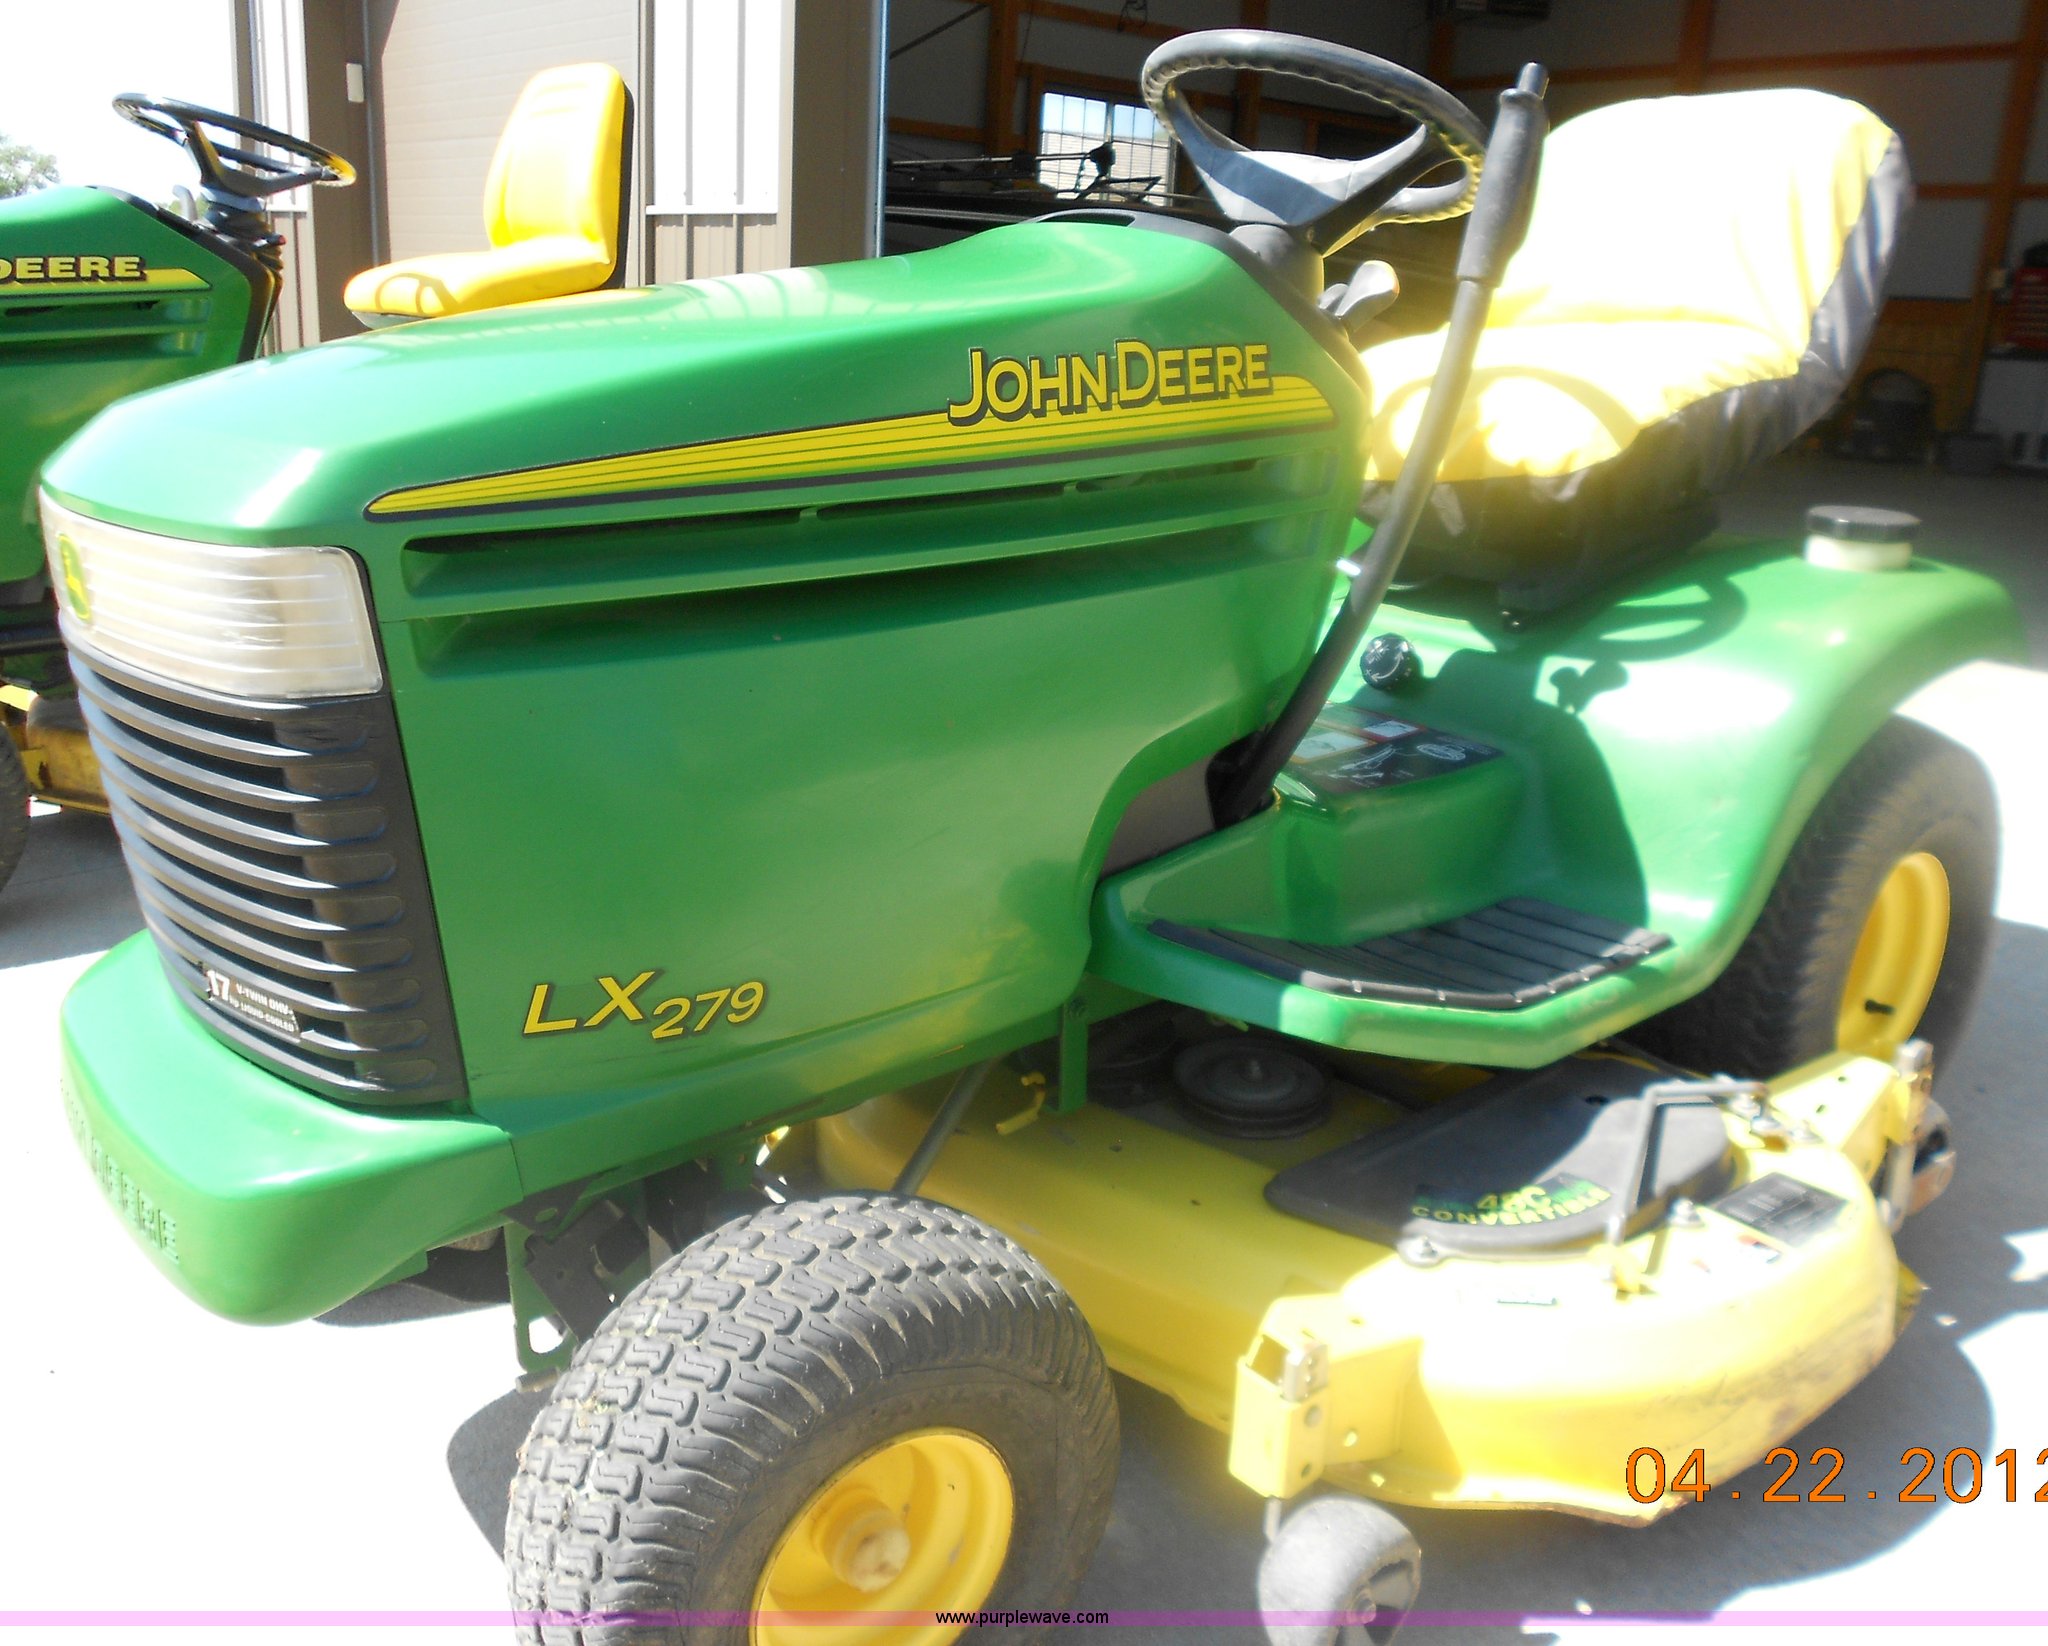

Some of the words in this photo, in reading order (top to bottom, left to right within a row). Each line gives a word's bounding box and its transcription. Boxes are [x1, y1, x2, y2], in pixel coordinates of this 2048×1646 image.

[948, 348, 1108, 423] JOHN
[1114, 339, 1272, 404] DEERE
[207, 970, 230, 1001] 17
